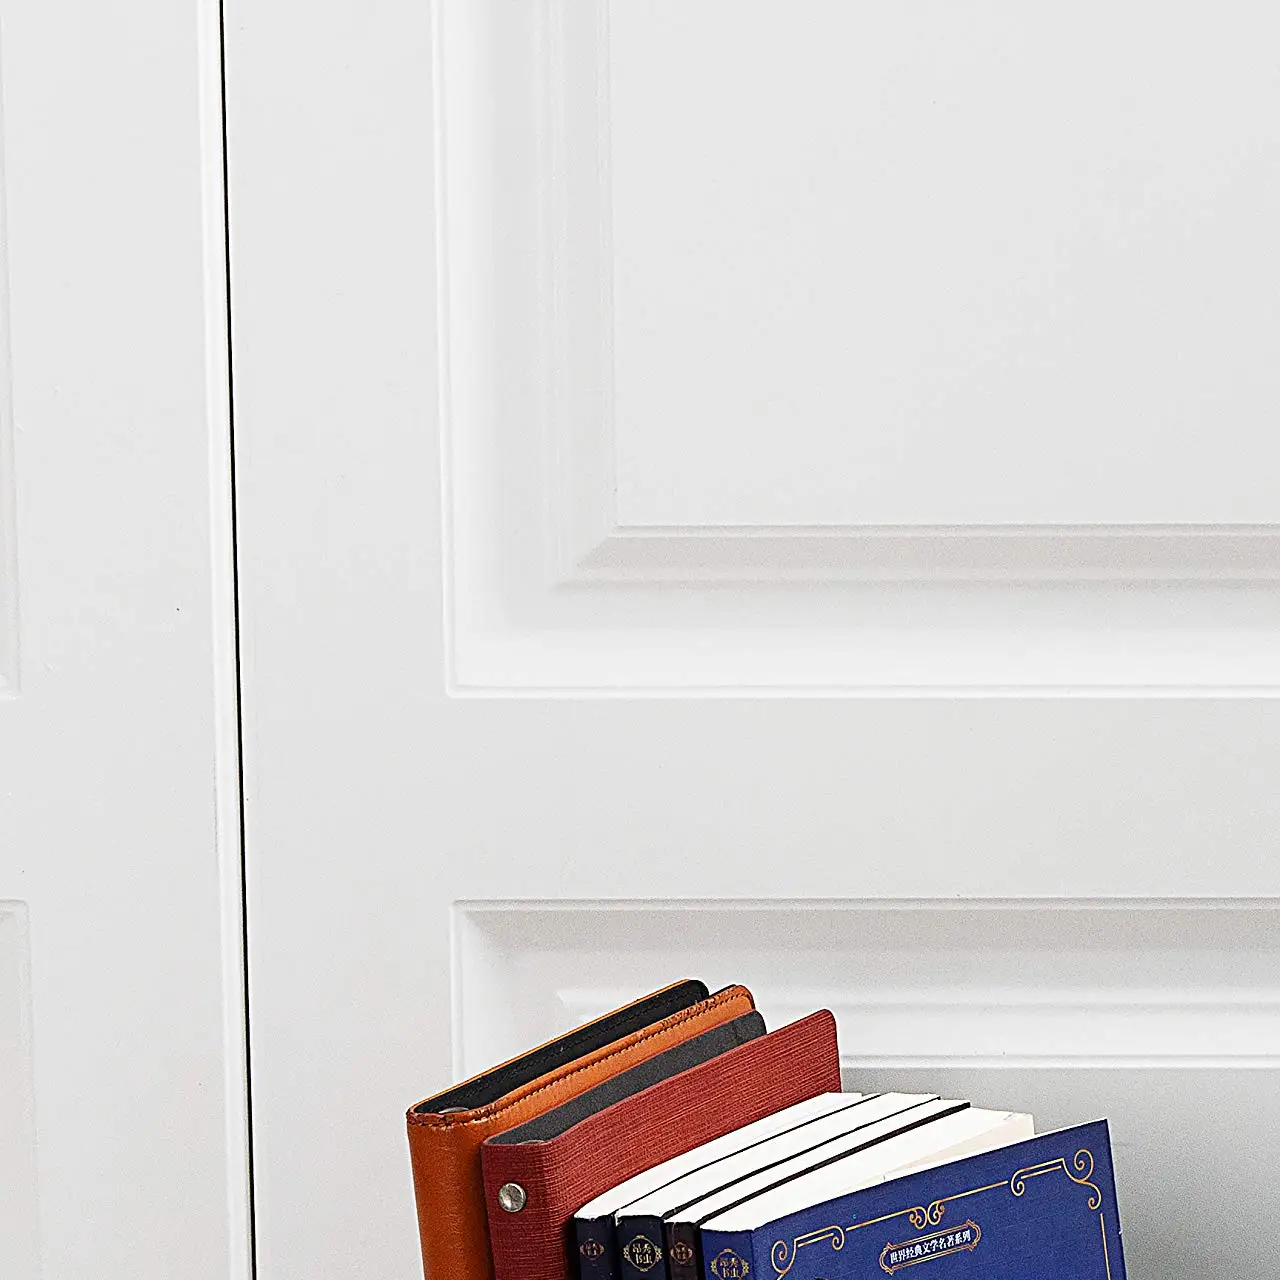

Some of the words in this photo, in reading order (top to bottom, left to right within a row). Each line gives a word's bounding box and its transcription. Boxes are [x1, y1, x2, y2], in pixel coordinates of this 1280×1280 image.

[890, 1229, 971, 1264] 世界经典文学名著系列
